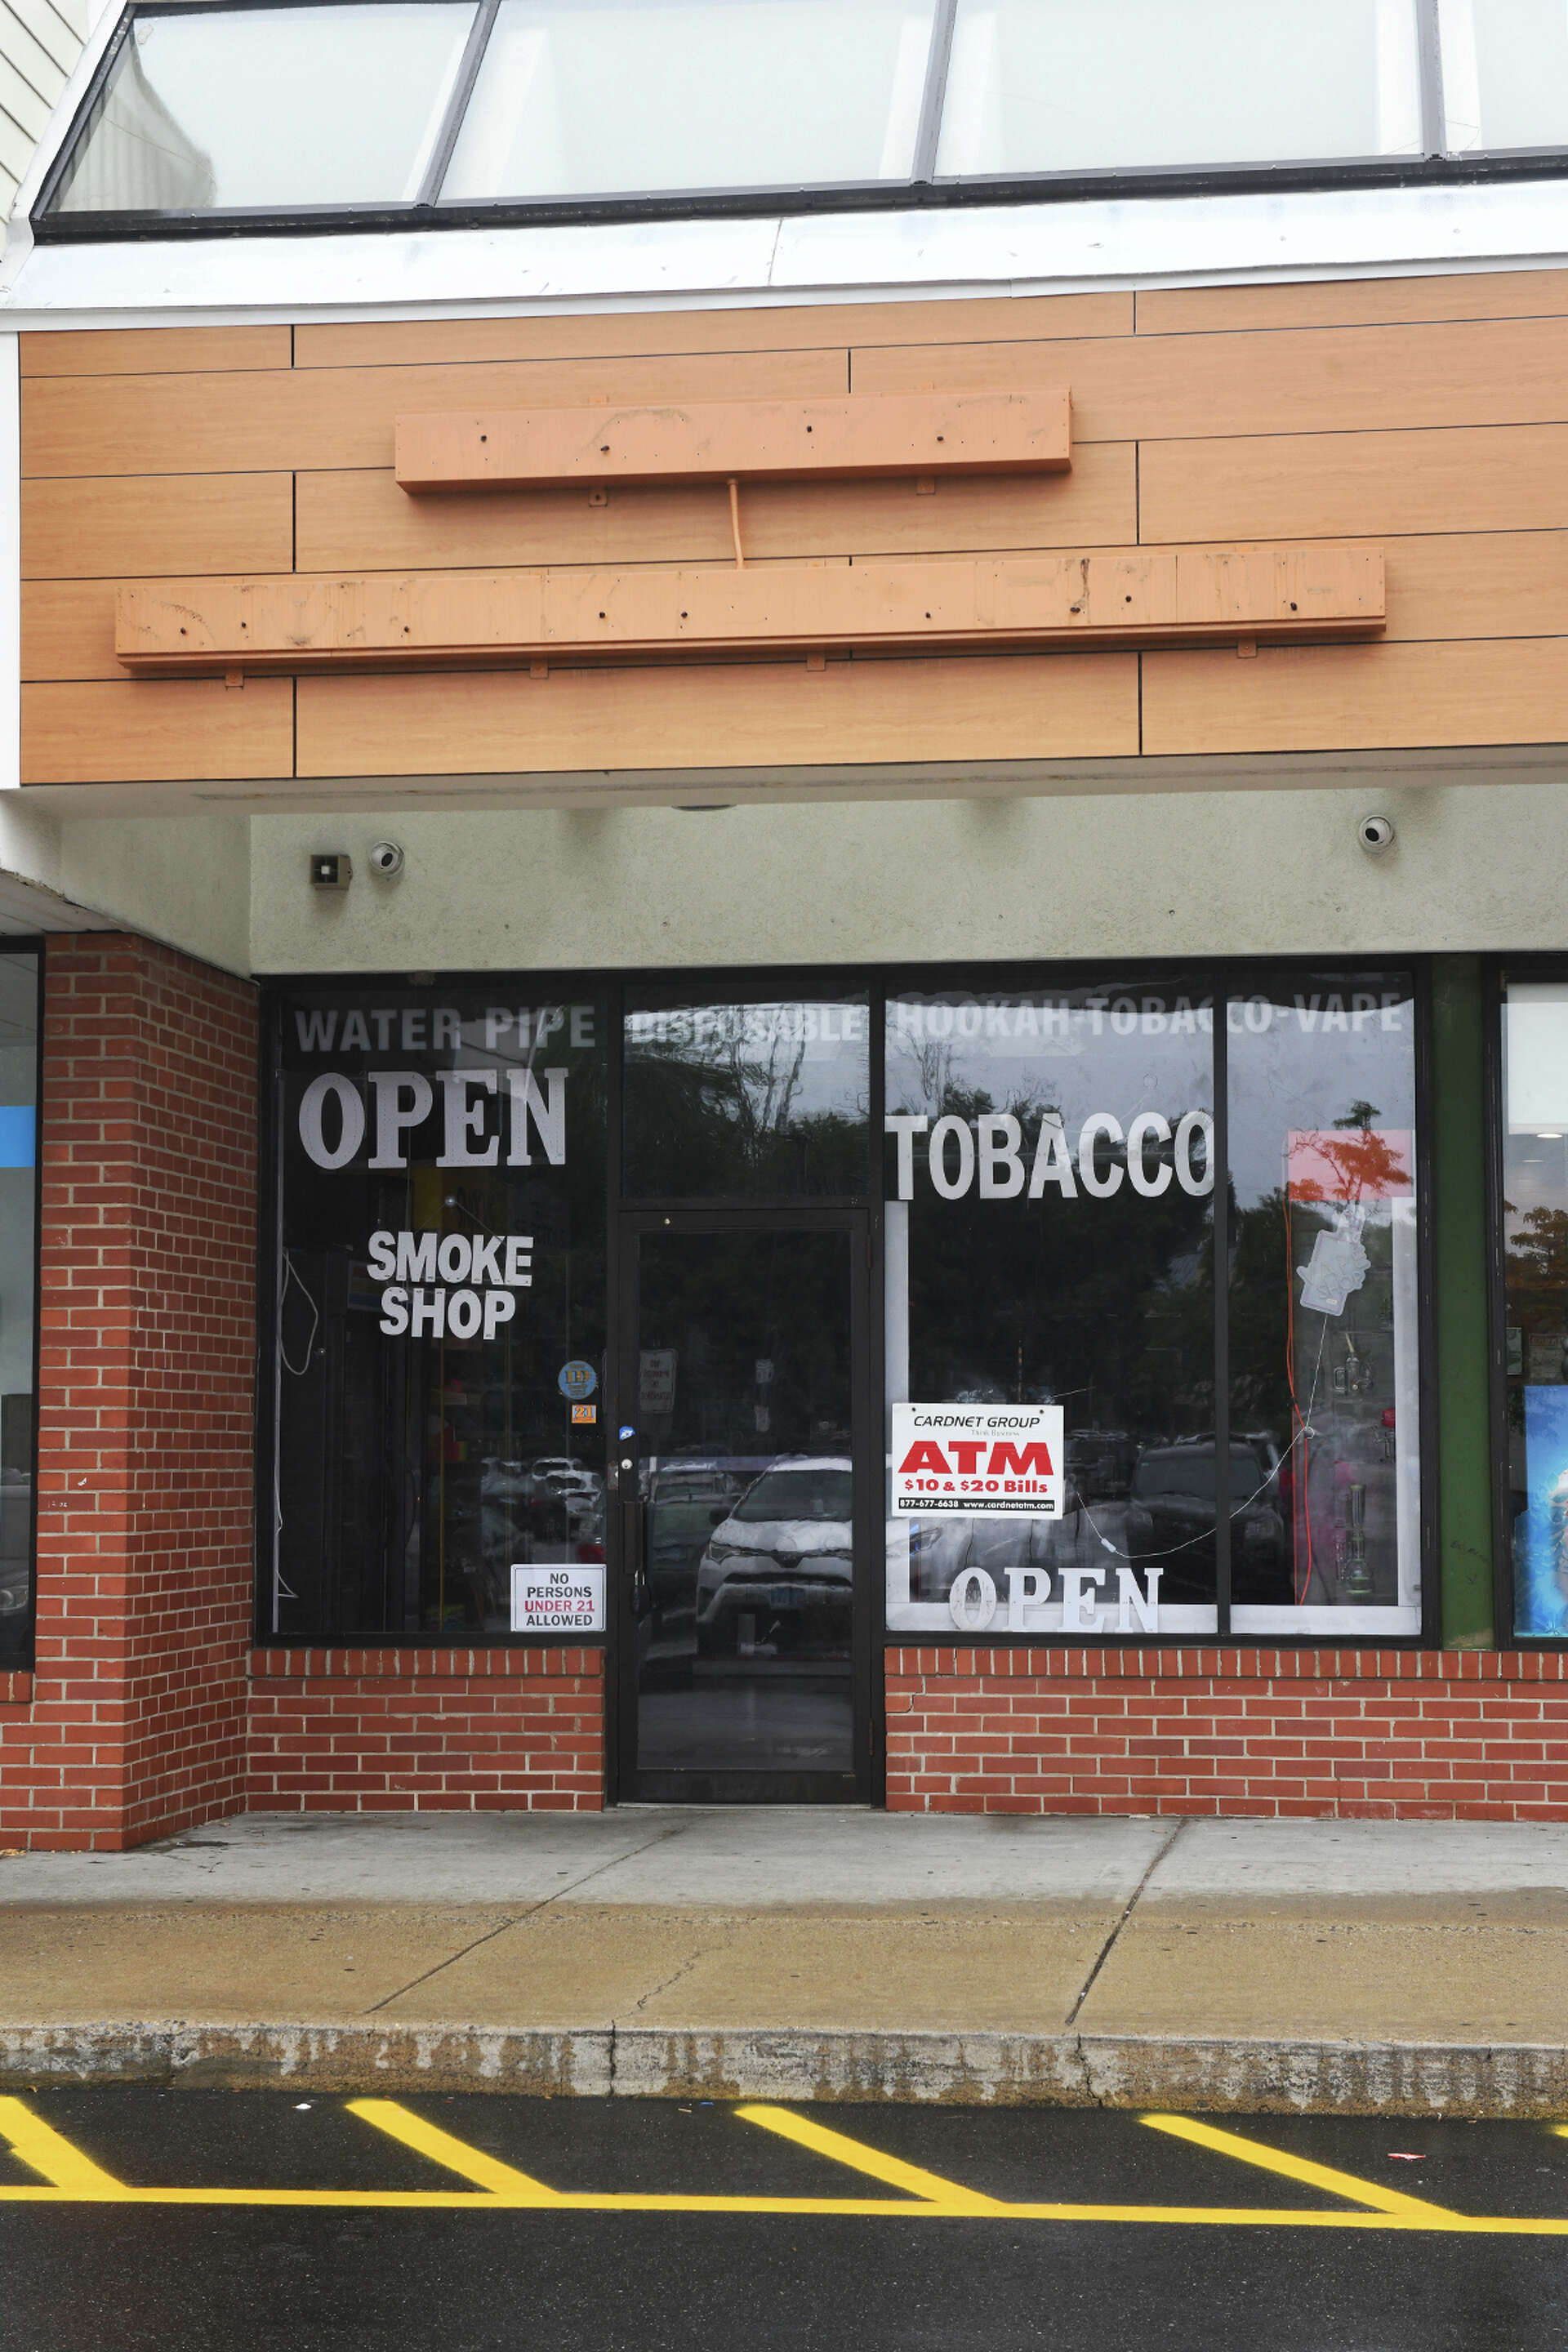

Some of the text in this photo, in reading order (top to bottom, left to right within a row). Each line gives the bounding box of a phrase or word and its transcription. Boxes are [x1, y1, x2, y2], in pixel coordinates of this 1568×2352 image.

[295, 1005, 595, 1052] WATER PIPE
[299, 1067, 569, 1170] OPEN
[884, 1111, 1215, 1201] TOBACCO
[367, 1231, 534, 1287] SMOKE
[380, 1287, 516, 1340] SHOP
[575, 1405, 594, 1419] 21
[914, 1415, 1040, 1428] CARDNET GROUP
[898, 1441, 1054, 1476] ATM
[904, 1478, 1048, 1494] $10 & $20 Bills
[899, 1499, 1054, 1510] 877-677-6638 www.cardnetatm.com
[550, 1572, 569, 1585] NO
[527, 1586, 593, 1598] PERSONS
[949, 1566, 1164, 1633] OPEN
[525, 1600, 595, 1612] UNDER 21
[526, 1614, 593, 1627] ALLOWED
